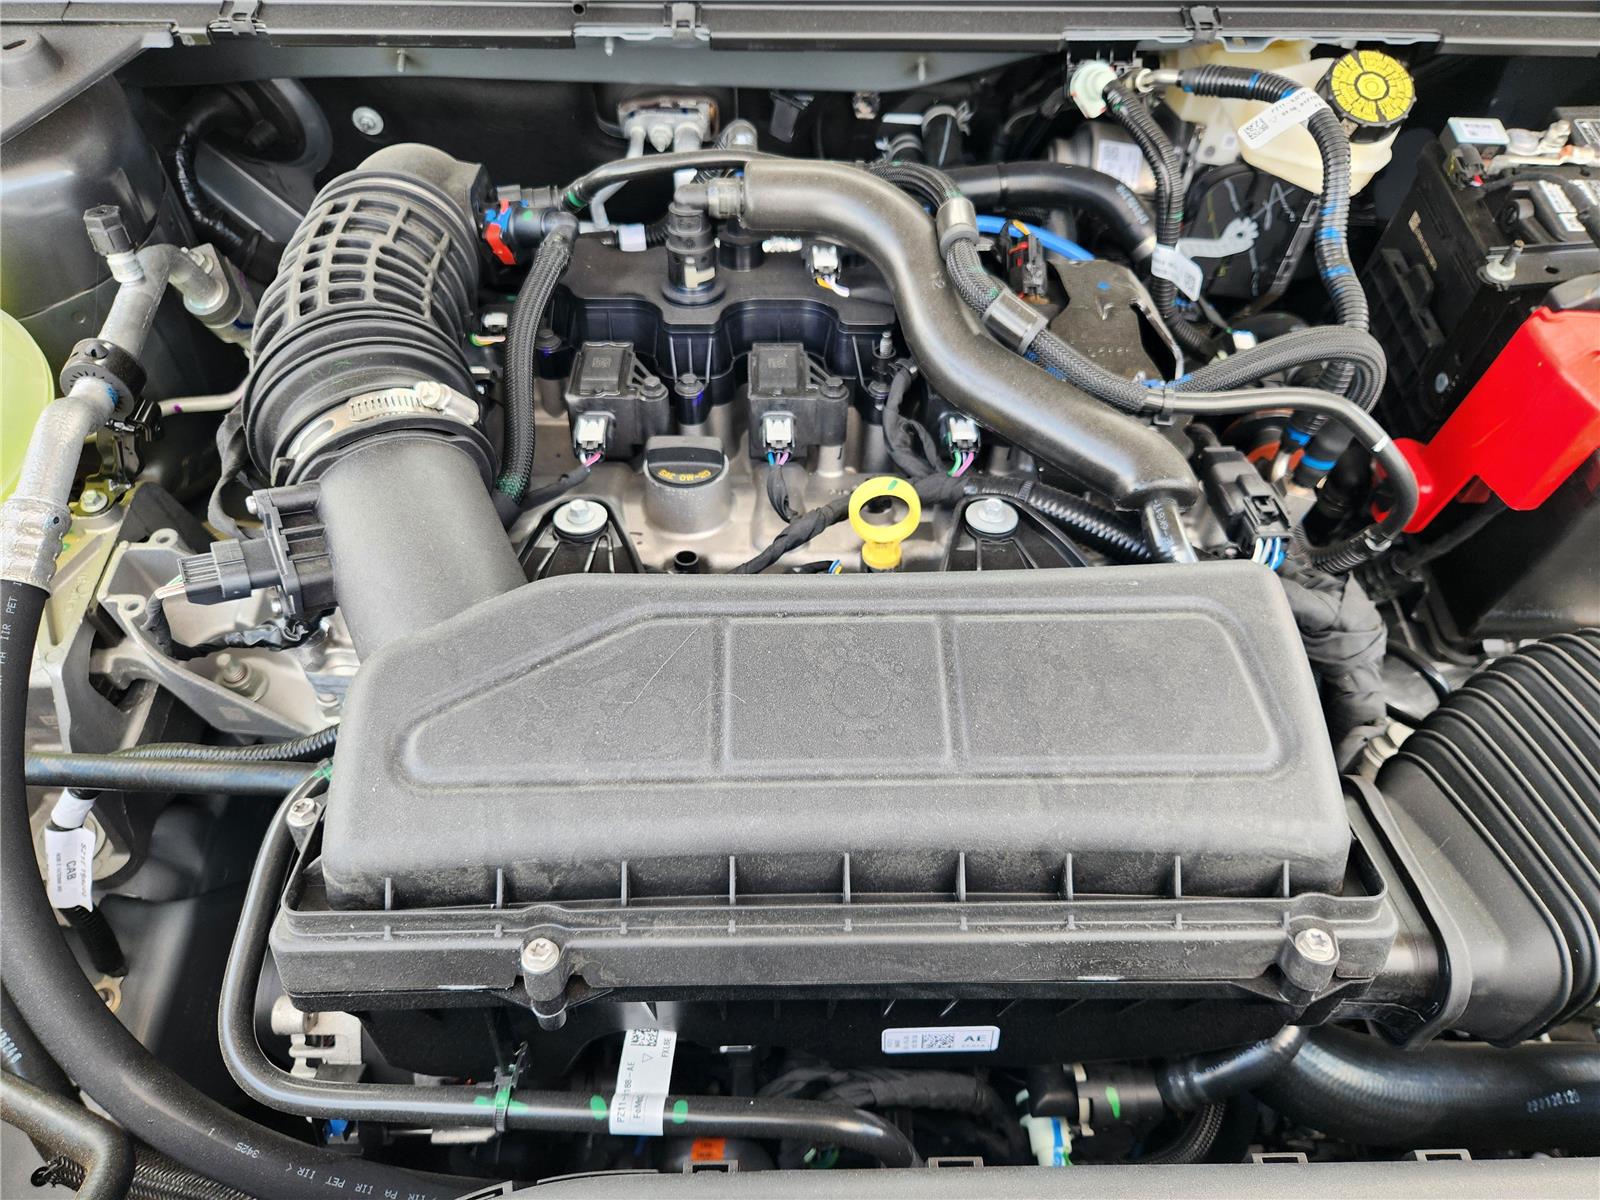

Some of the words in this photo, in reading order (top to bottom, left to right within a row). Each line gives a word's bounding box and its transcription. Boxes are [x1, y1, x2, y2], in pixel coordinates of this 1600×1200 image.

[5, 595, 18, 615] PET
[66, 860, 77, 881] CAB
[234, 1142, 260, 1159] 3425
[325, 1175, 346, 1188] PET
